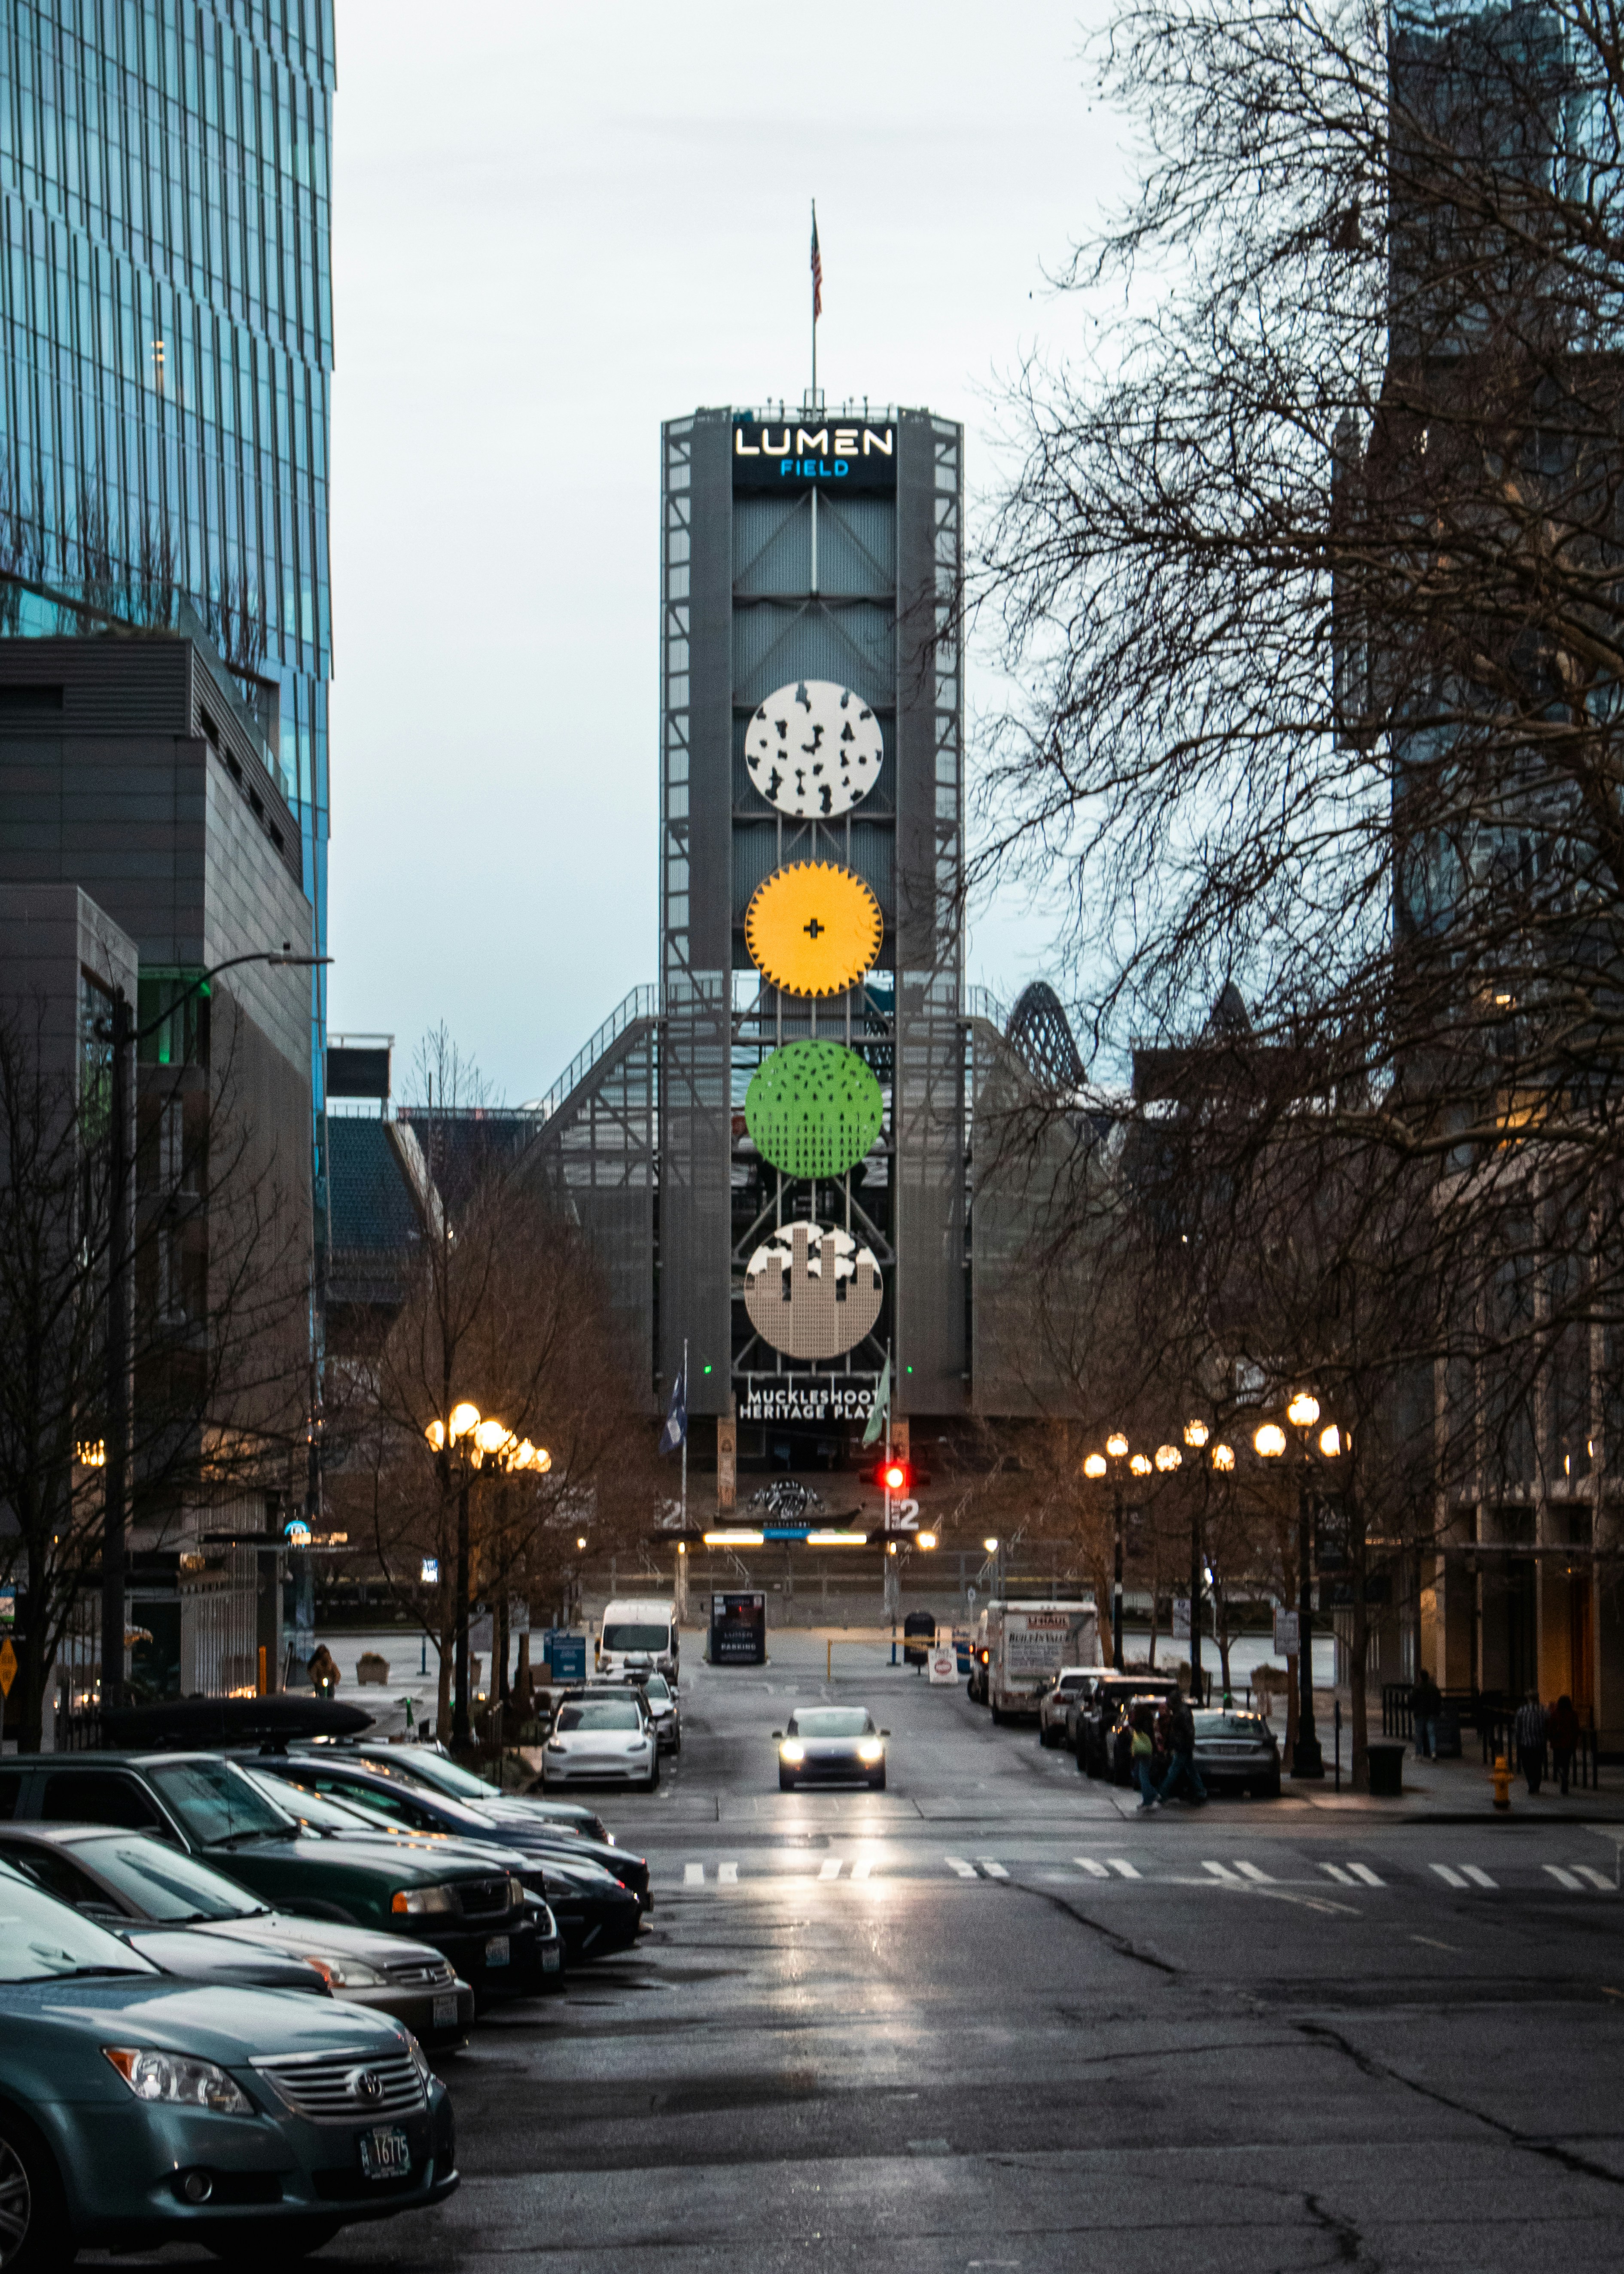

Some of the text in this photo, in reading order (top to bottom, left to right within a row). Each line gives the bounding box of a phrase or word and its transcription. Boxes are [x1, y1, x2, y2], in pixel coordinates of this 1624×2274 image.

[736, 428, 892, 455] LUMEN
[780, 459, 849, 477] FIELD
[740, 1404, 825, 1419] HERITAGE
[901, 1498, 919, 1530] 2
[374, 2136, 409, 2165] 16775
